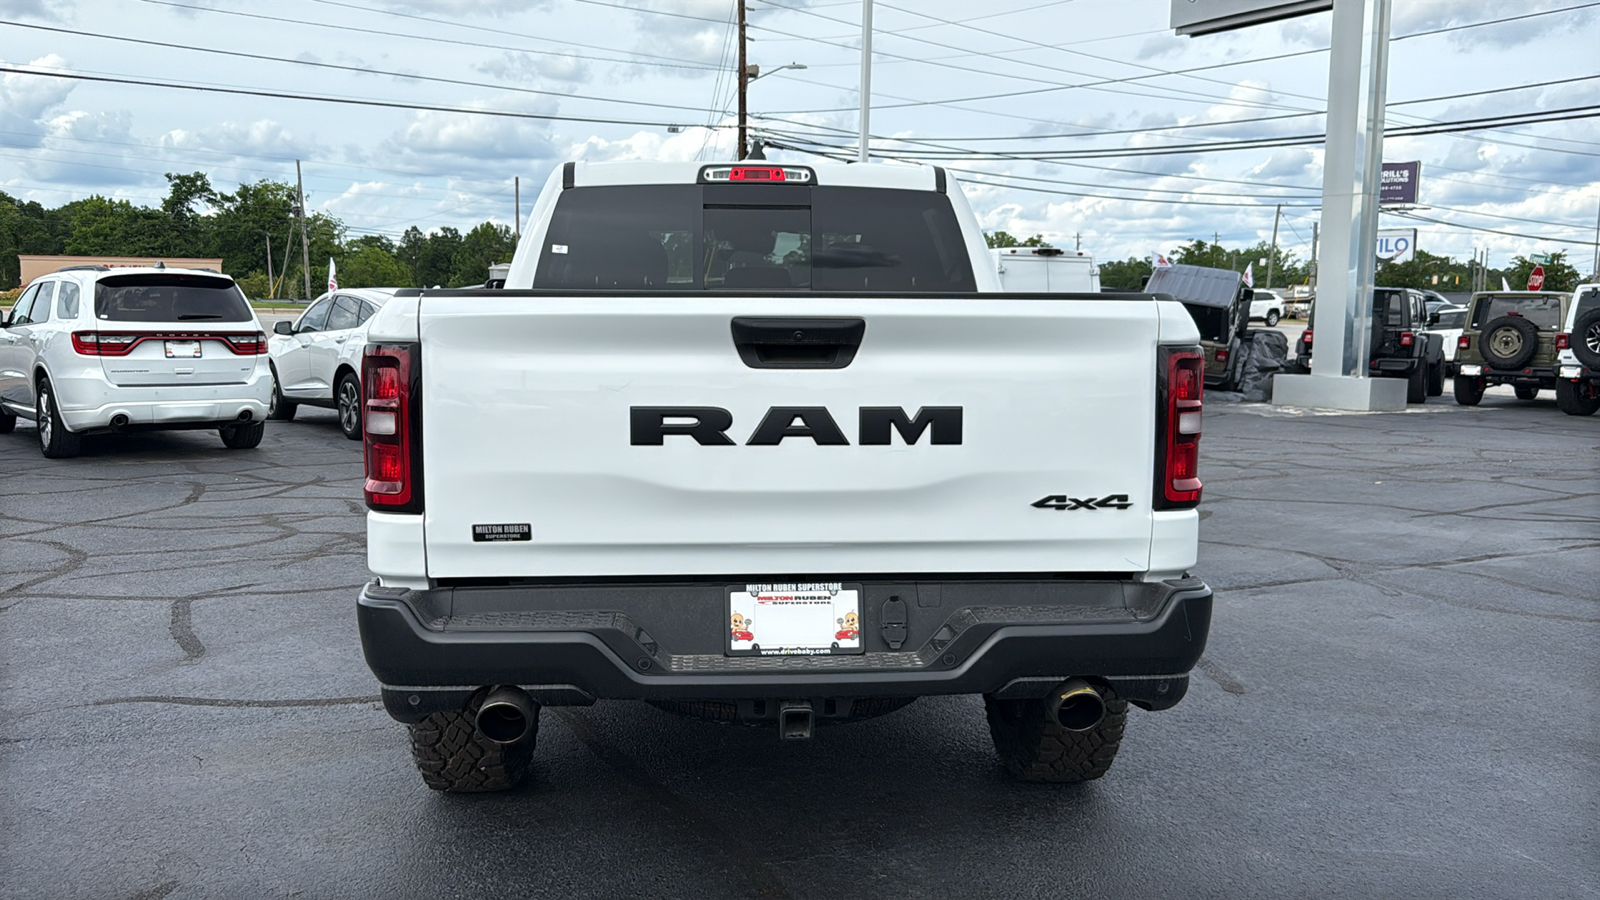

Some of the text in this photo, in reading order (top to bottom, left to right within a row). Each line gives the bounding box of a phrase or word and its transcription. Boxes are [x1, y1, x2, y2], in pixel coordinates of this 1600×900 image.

[1381, 170, 1409, 178] RILL'S
[1378, 237, 1409, 253] ILO
[1528, 275, 1543, 286] STOP
[630, 406, 963, 446] RAM
[1030, 494, 1134, 510] 4x4
[475, 525, 529, 533] MILTON RUBEN
[746, 583, 842, 592] MILTON RUBEN SUPERSTORE
